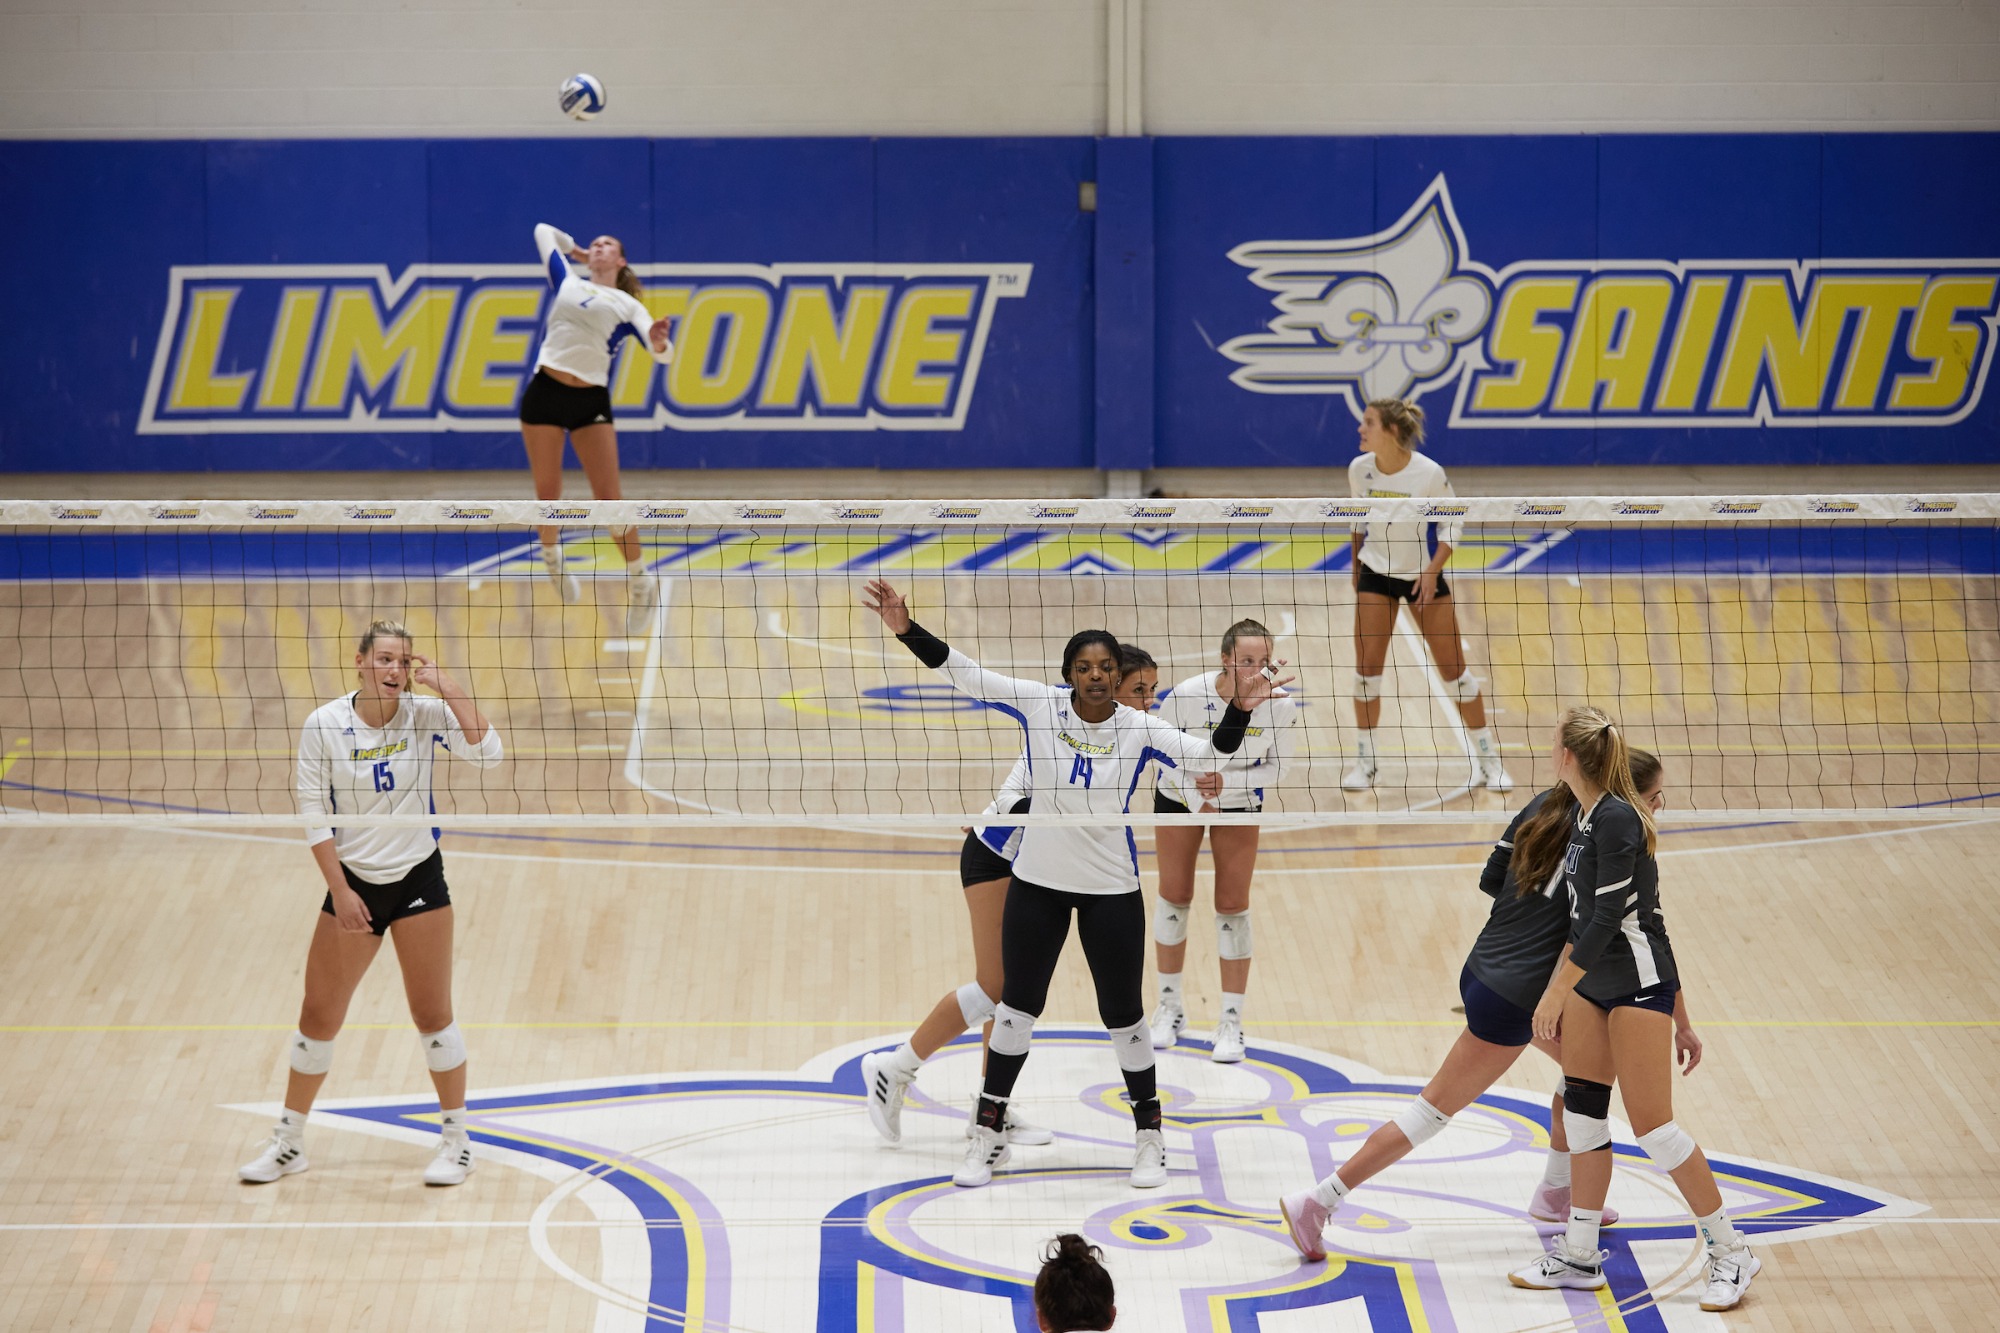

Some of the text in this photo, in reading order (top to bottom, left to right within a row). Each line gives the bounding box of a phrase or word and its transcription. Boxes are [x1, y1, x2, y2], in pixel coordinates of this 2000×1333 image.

[167, 285, 979, 412] LIMETONE
[1469, 273, 1998, 412] SAINTS
[350, 737, 408, 761] LIMESTONE
[1057, 730, 1116, 755] LIMESTONE
[373, 761, 395, 793] 15
[1069, 753, 1093, 790] 14
